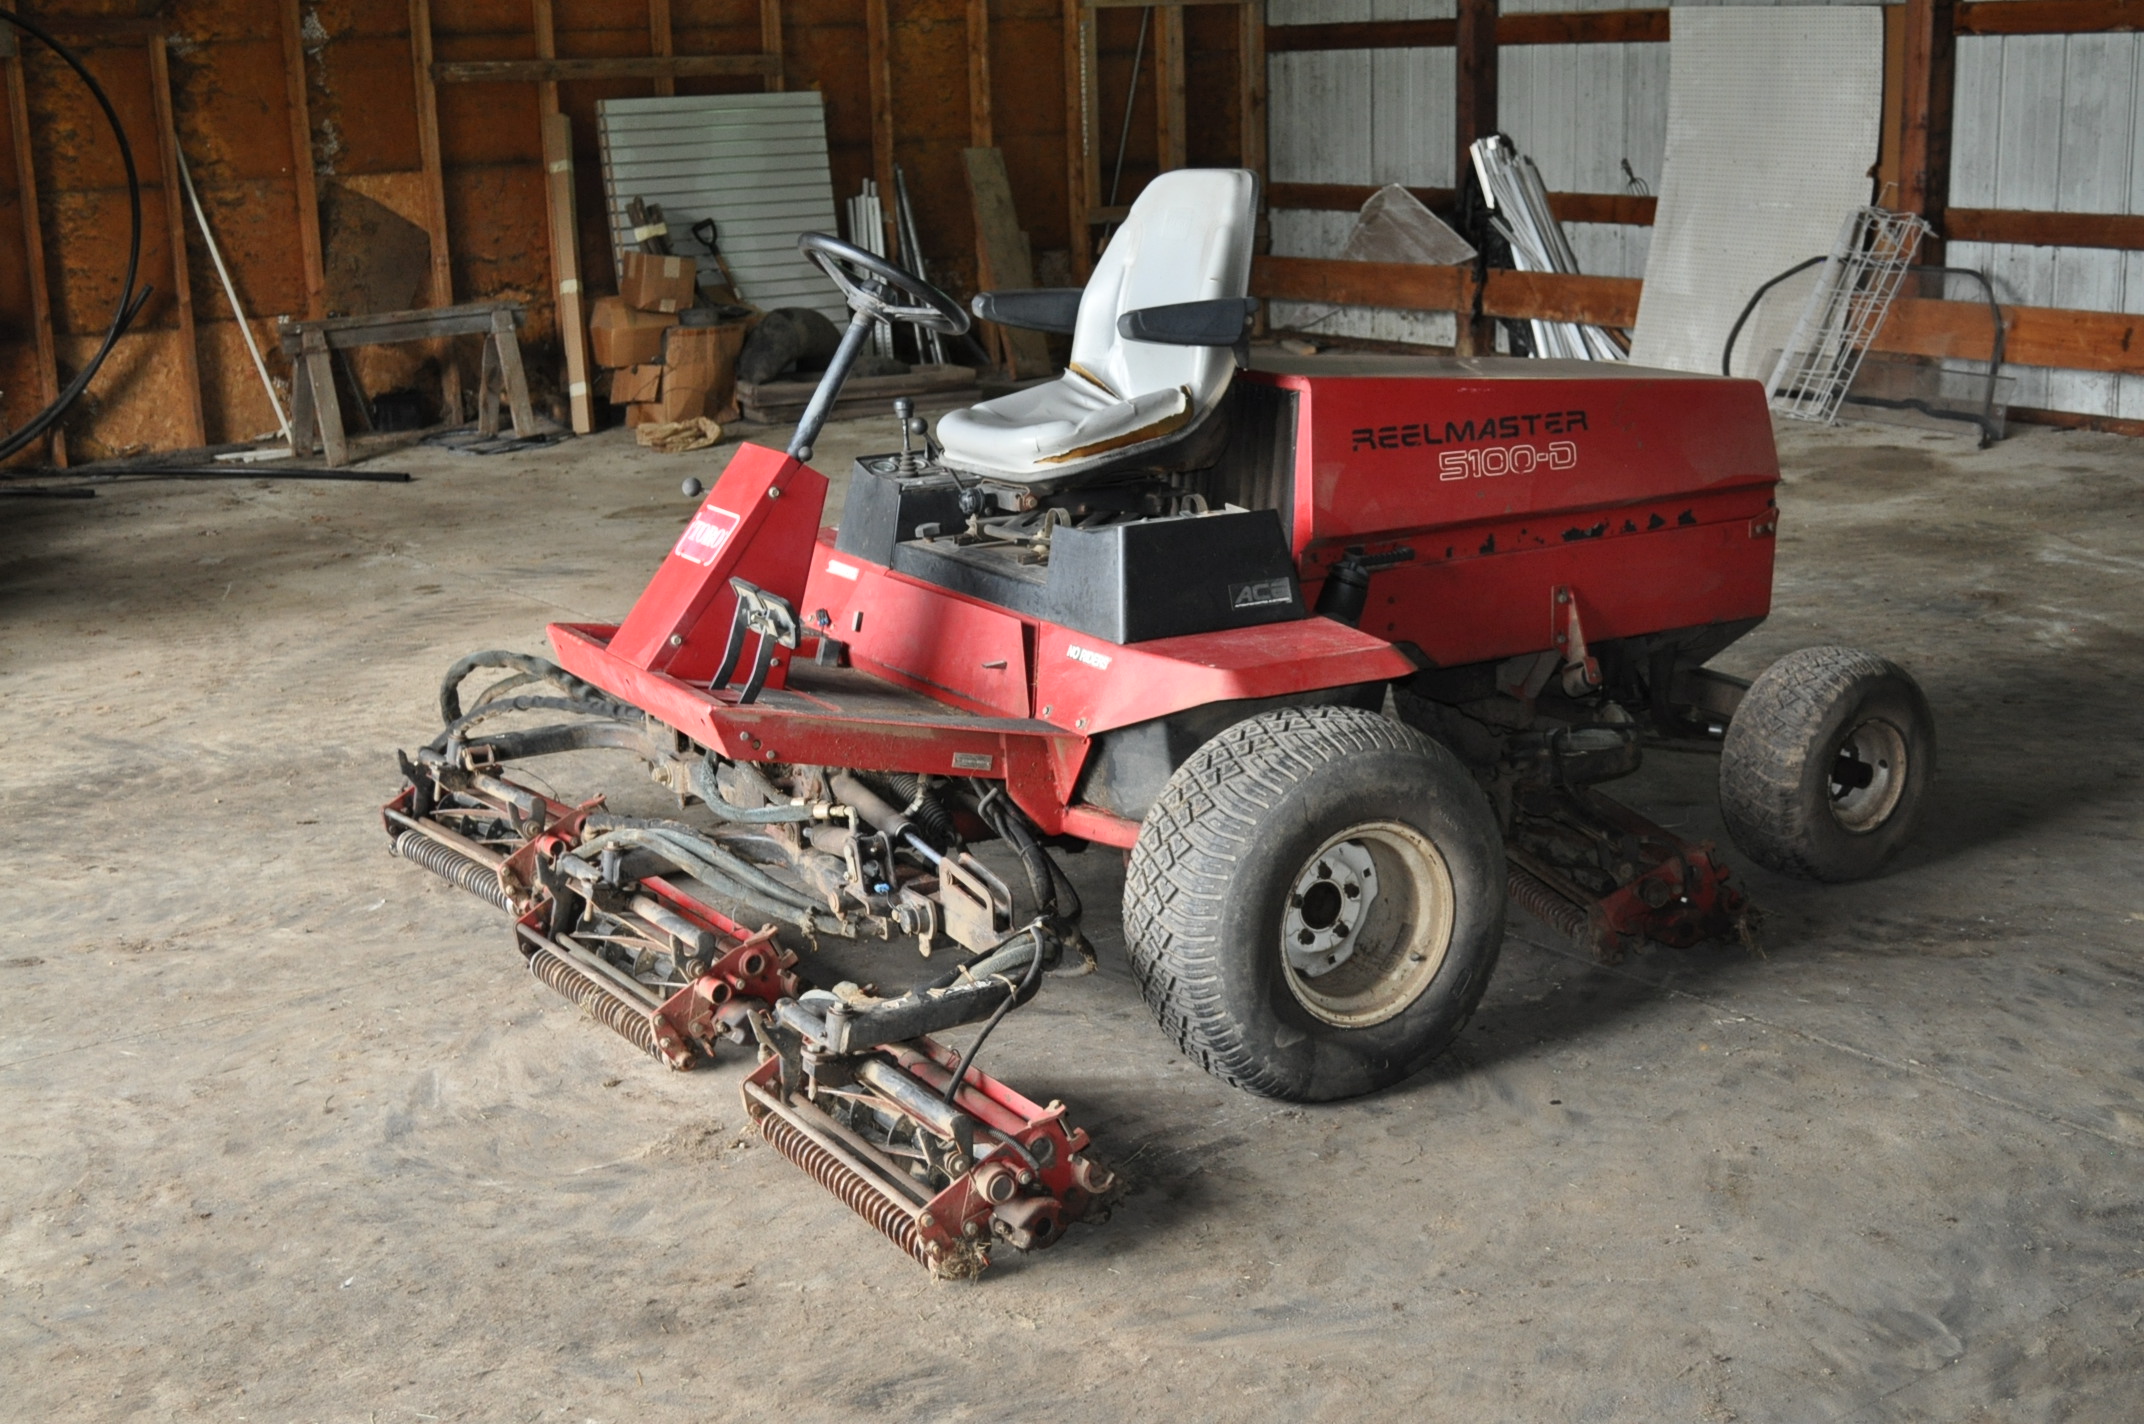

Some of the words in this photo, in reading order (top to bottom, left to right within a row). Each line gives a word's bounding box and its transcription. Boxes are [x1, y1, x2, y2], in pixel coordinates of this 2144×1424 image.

[1352, 410, 1588, 451] REELMASTER
[1439, 441, 1577, 482] 5100-D
[687, 520, 726, 549] TORO
[1066, 644, 1081, 660] NO
